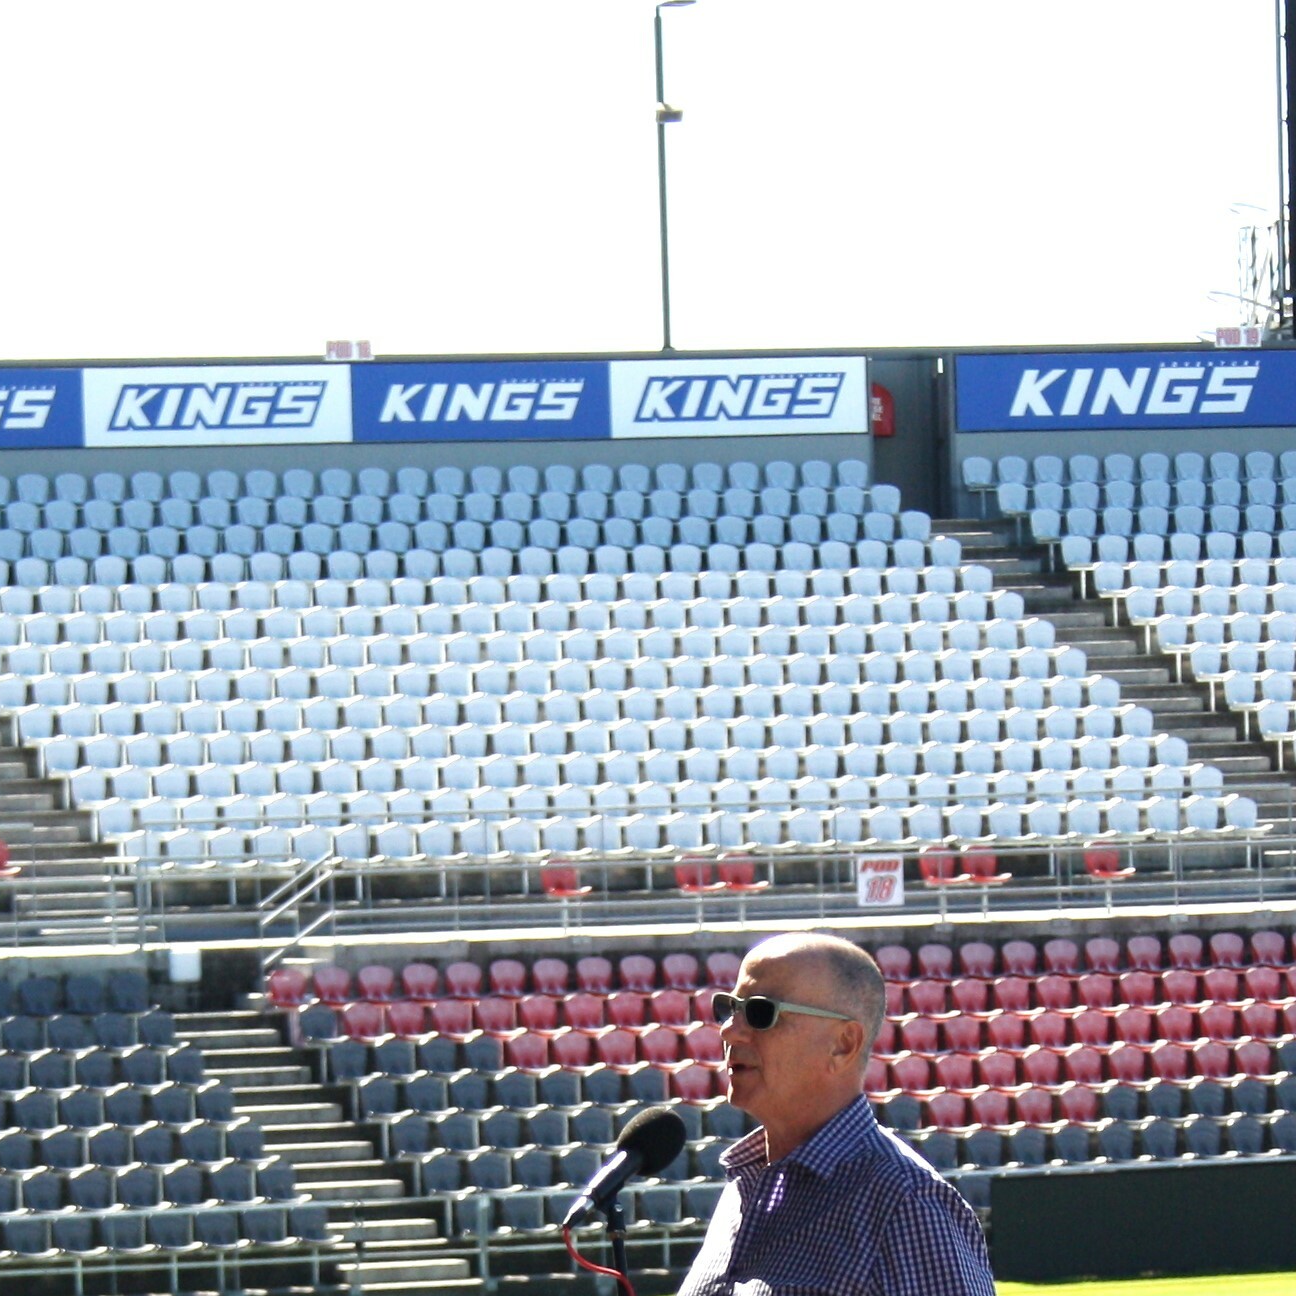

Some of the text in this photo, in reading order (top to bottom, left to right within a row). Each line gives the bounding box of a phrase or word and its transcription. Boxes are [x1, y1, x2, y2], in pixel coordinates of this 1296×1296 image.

[110, 384, 325, 430] KINGS
[379, 382, 584, 423] KINGS
[635, 374, 844, 421] KINGS
[1008, 366, 1260, 417] KINGS
[860, 860, 900, 873] POD
[865, 874, 898, 903] 18
